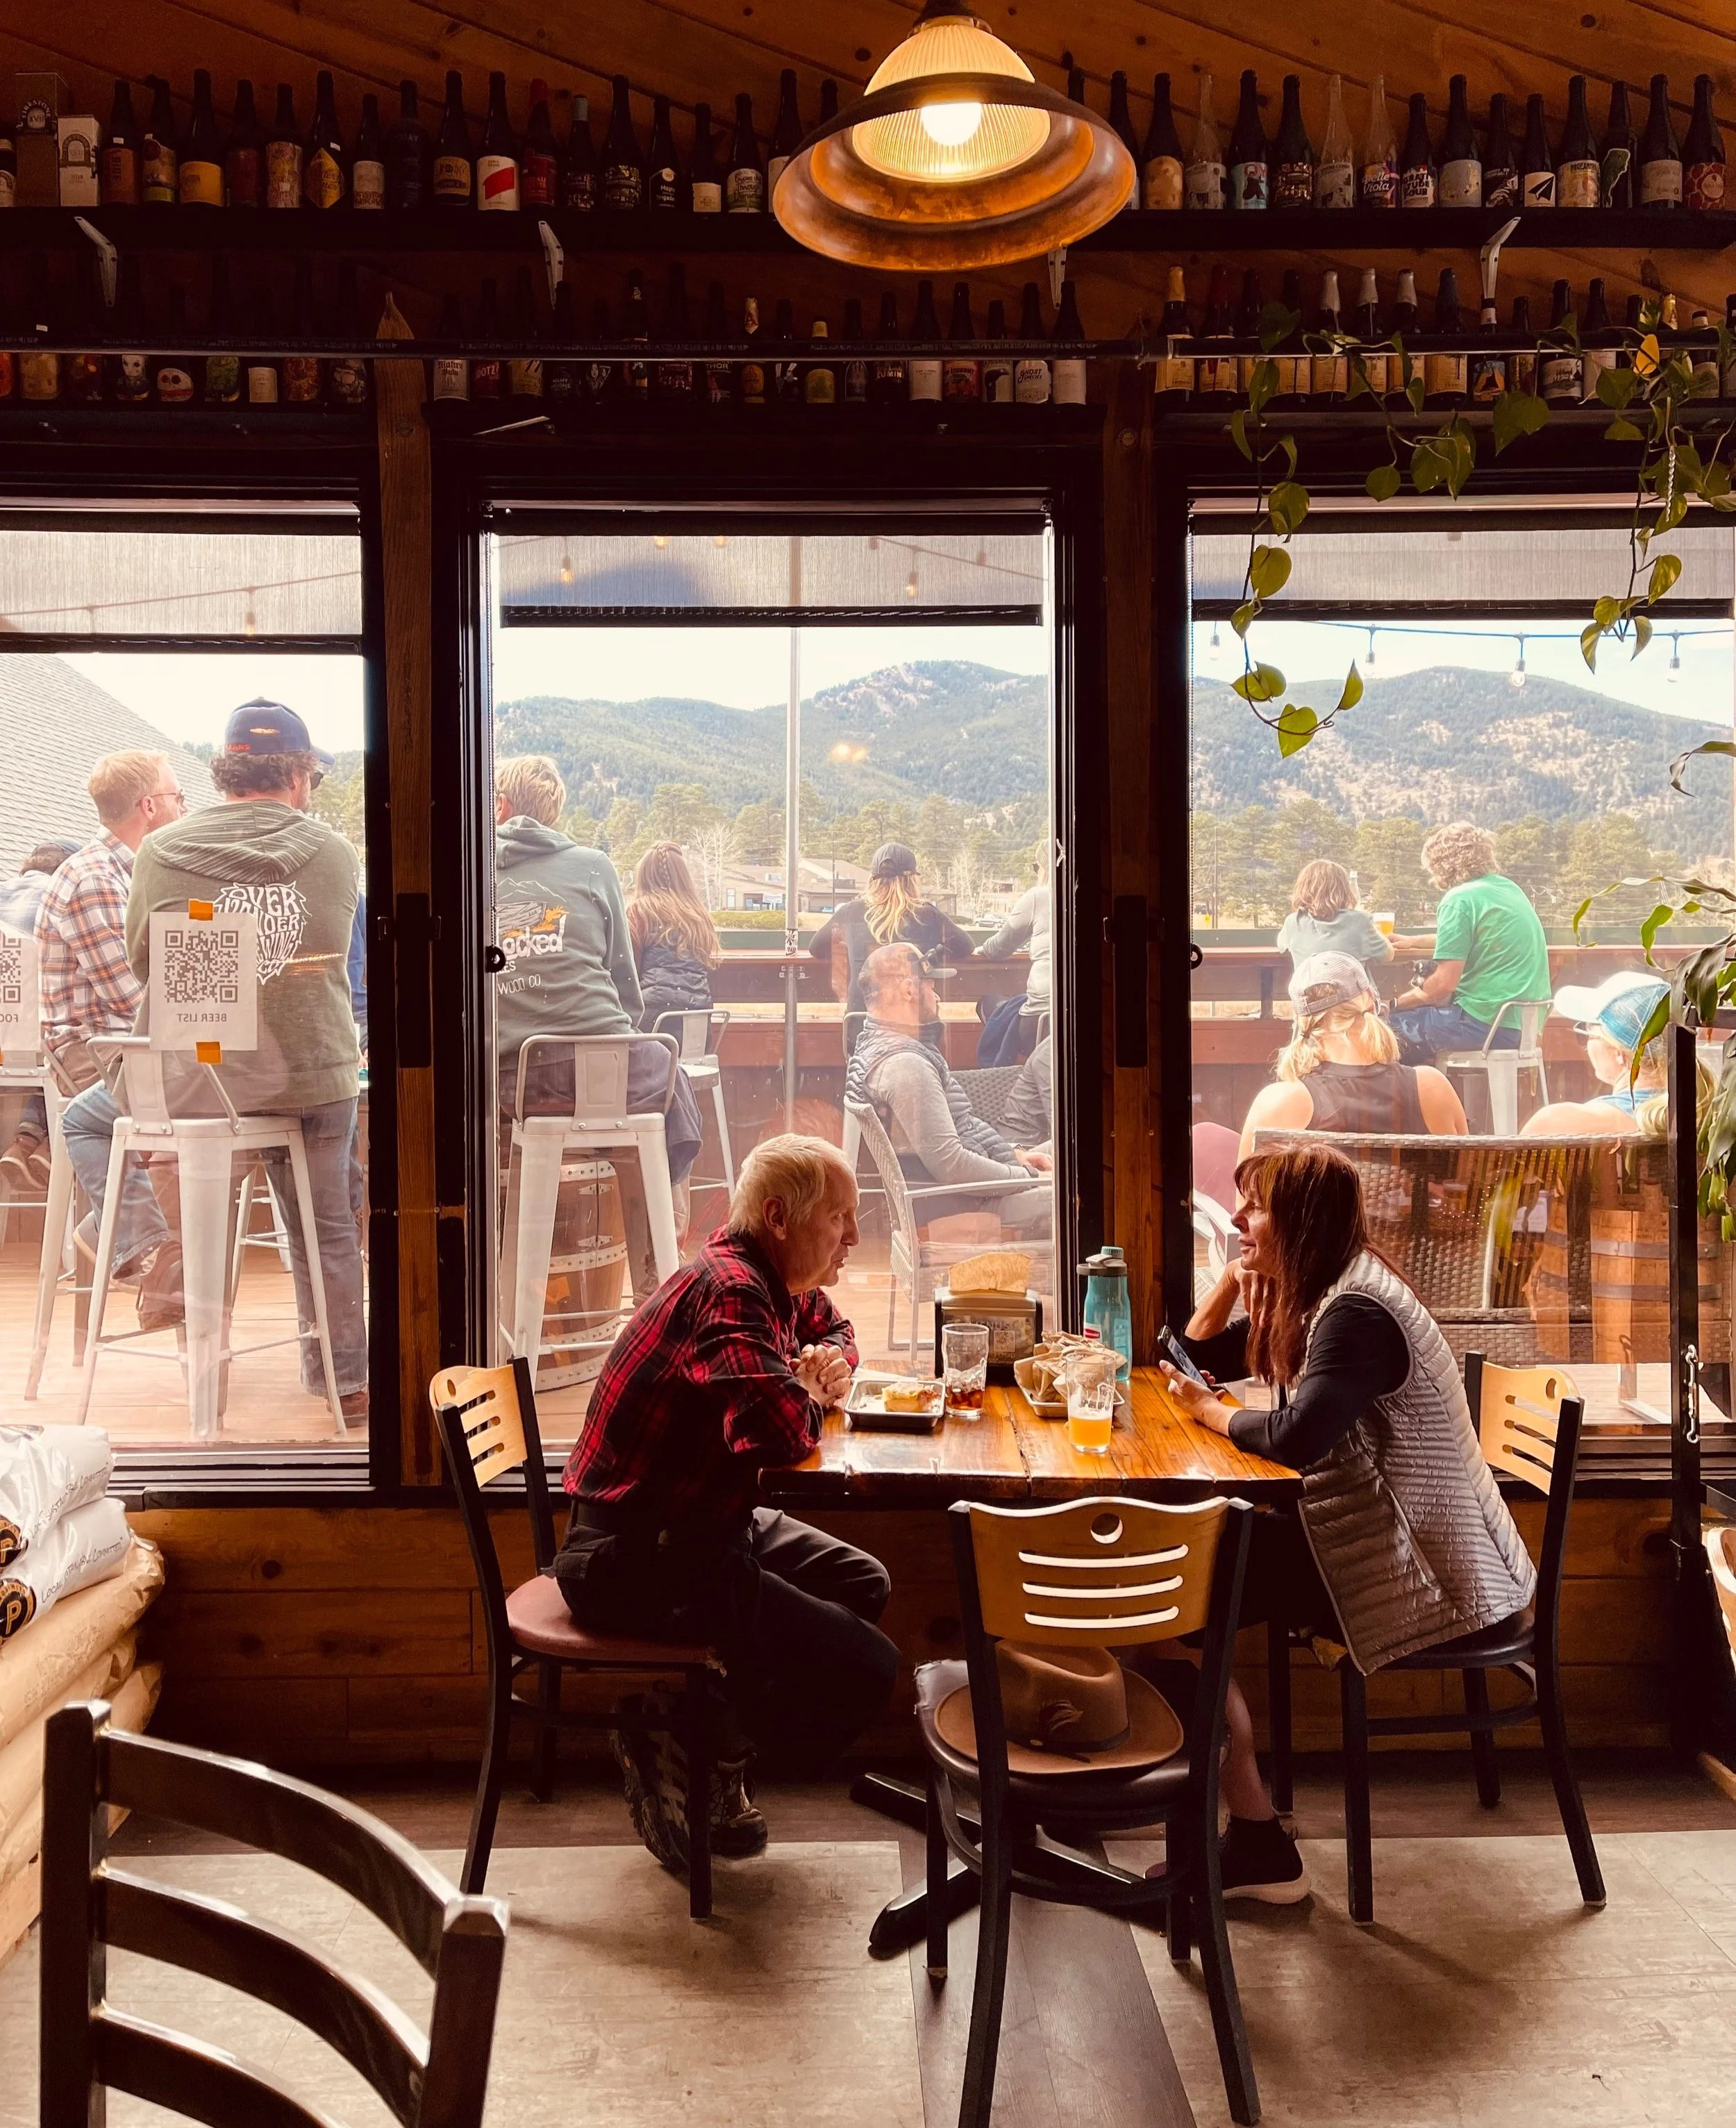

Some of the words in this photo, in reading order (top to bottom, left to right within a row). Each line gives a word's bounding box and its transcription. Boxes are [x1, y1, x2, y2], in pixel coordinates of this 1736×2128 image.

[1364, 181, 1389, 195] Viola
[1019, 369, 1042, 383] GHOST
[228, 886, 301, 917] OVER
[528, 974, 541, 988] CO
[41, 1581, 63, 1604] LOCAL
[6, 1600, 22, 1636] P
